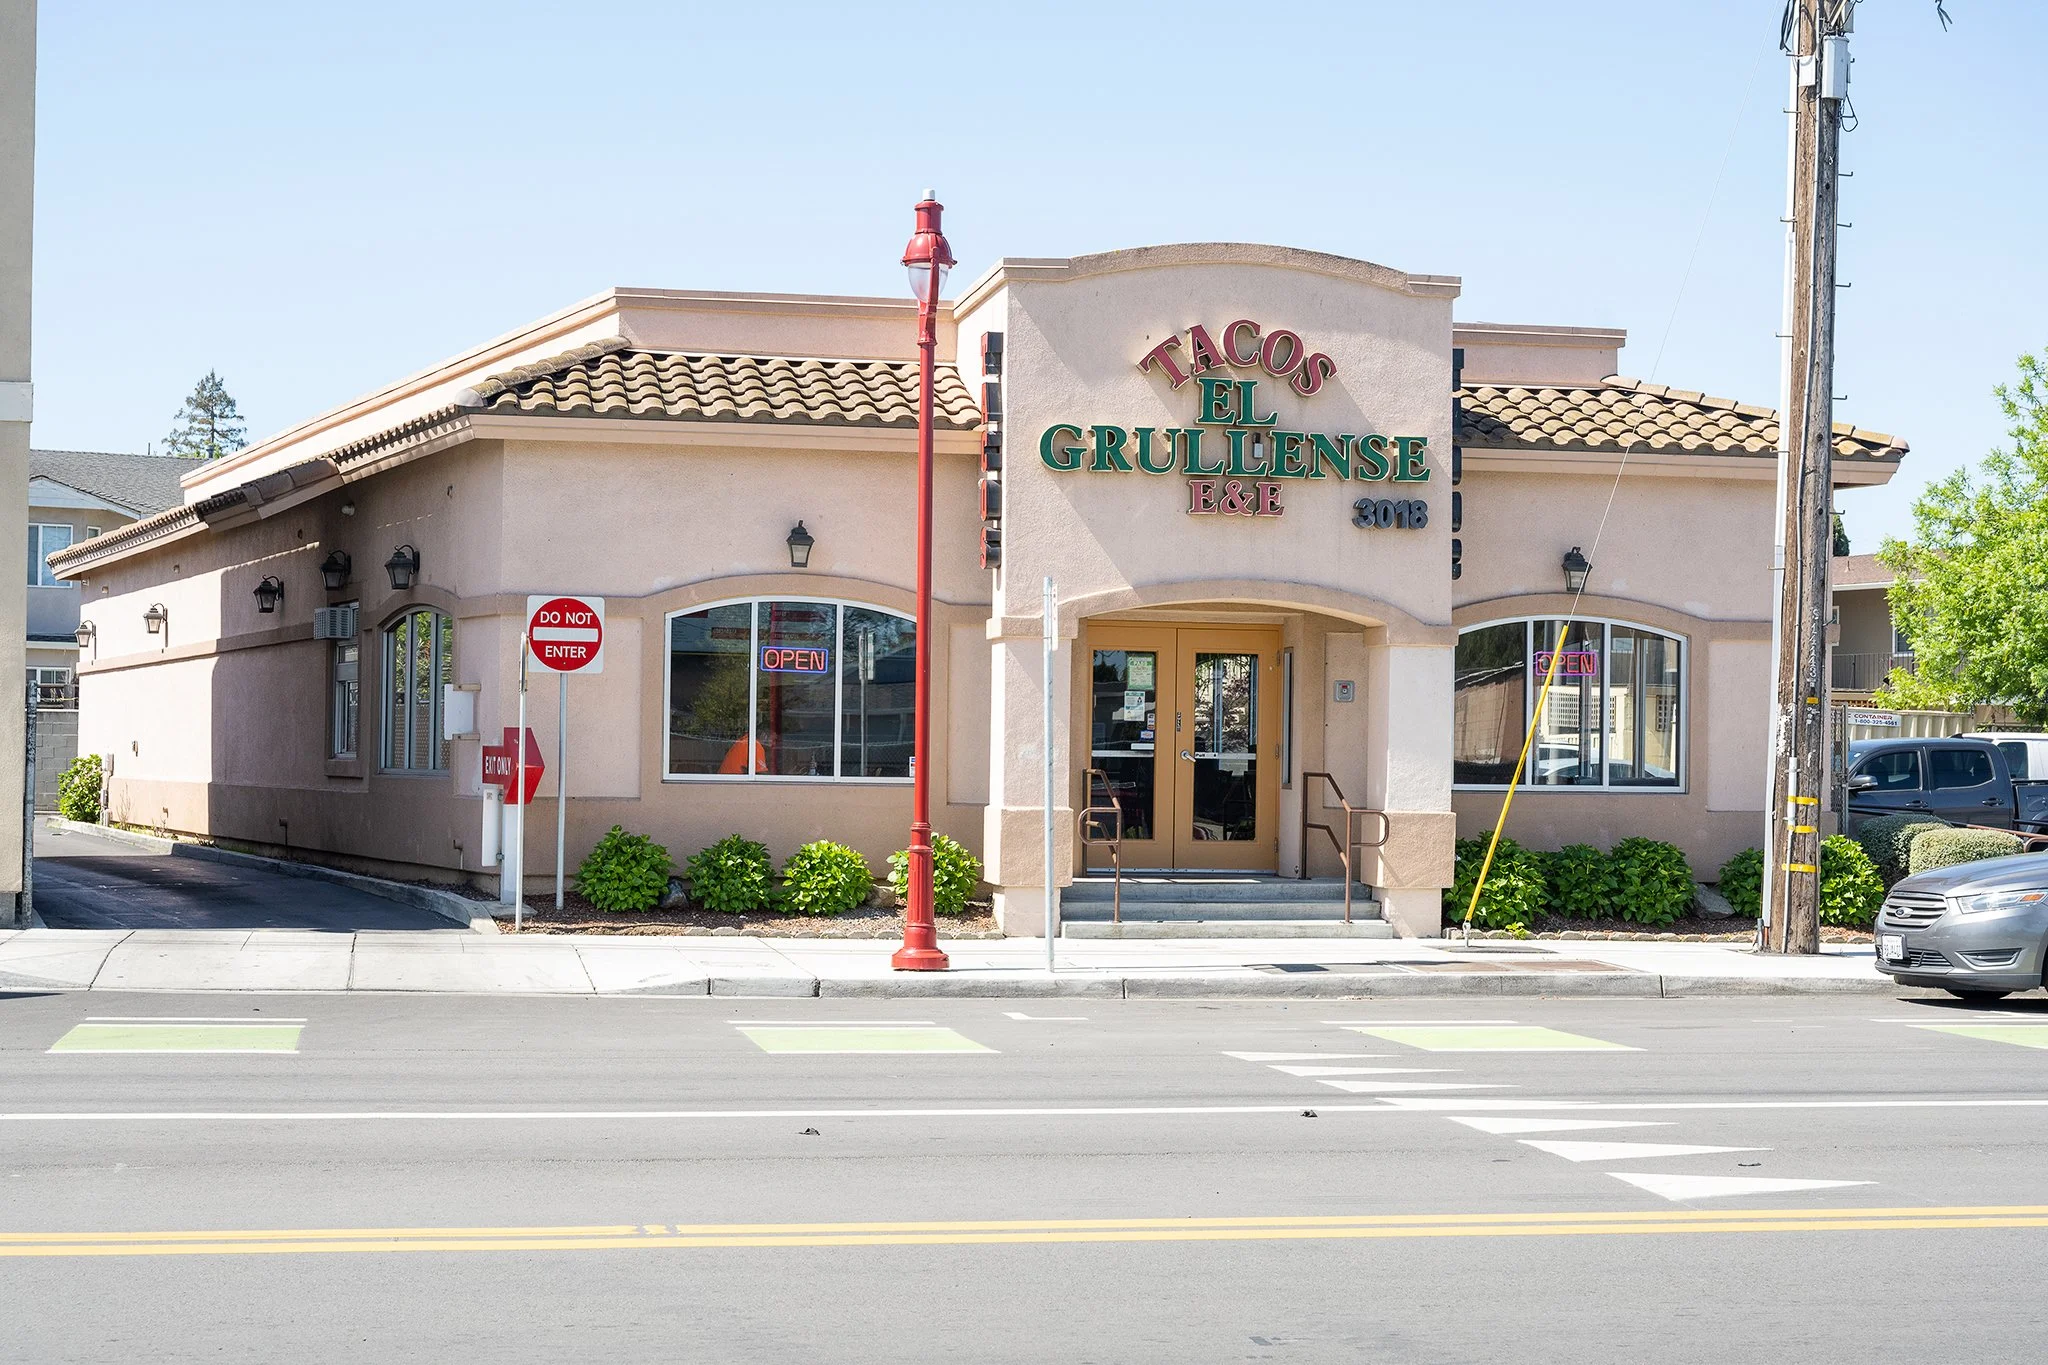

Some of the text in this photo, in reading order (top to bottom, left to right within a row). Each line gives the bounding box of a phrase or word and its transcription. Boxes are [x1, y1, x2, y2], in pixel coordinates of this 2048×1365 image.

[1136, 318, 1338, 398] TACOS
[1195, 376, 1279, 427] EL
[1038, 423, 1432, 484] GRULLENSE
[1186, 479, 1285, 518] E&E
[1352, 497, 1429, 530] 3018
[540, 611, 594, 625] DO NOT
[545, 645, 587, 659] ENTER
[764, 648, 825, 671] OPEN
[485, 755, 512, 776] EXIT ONLY
